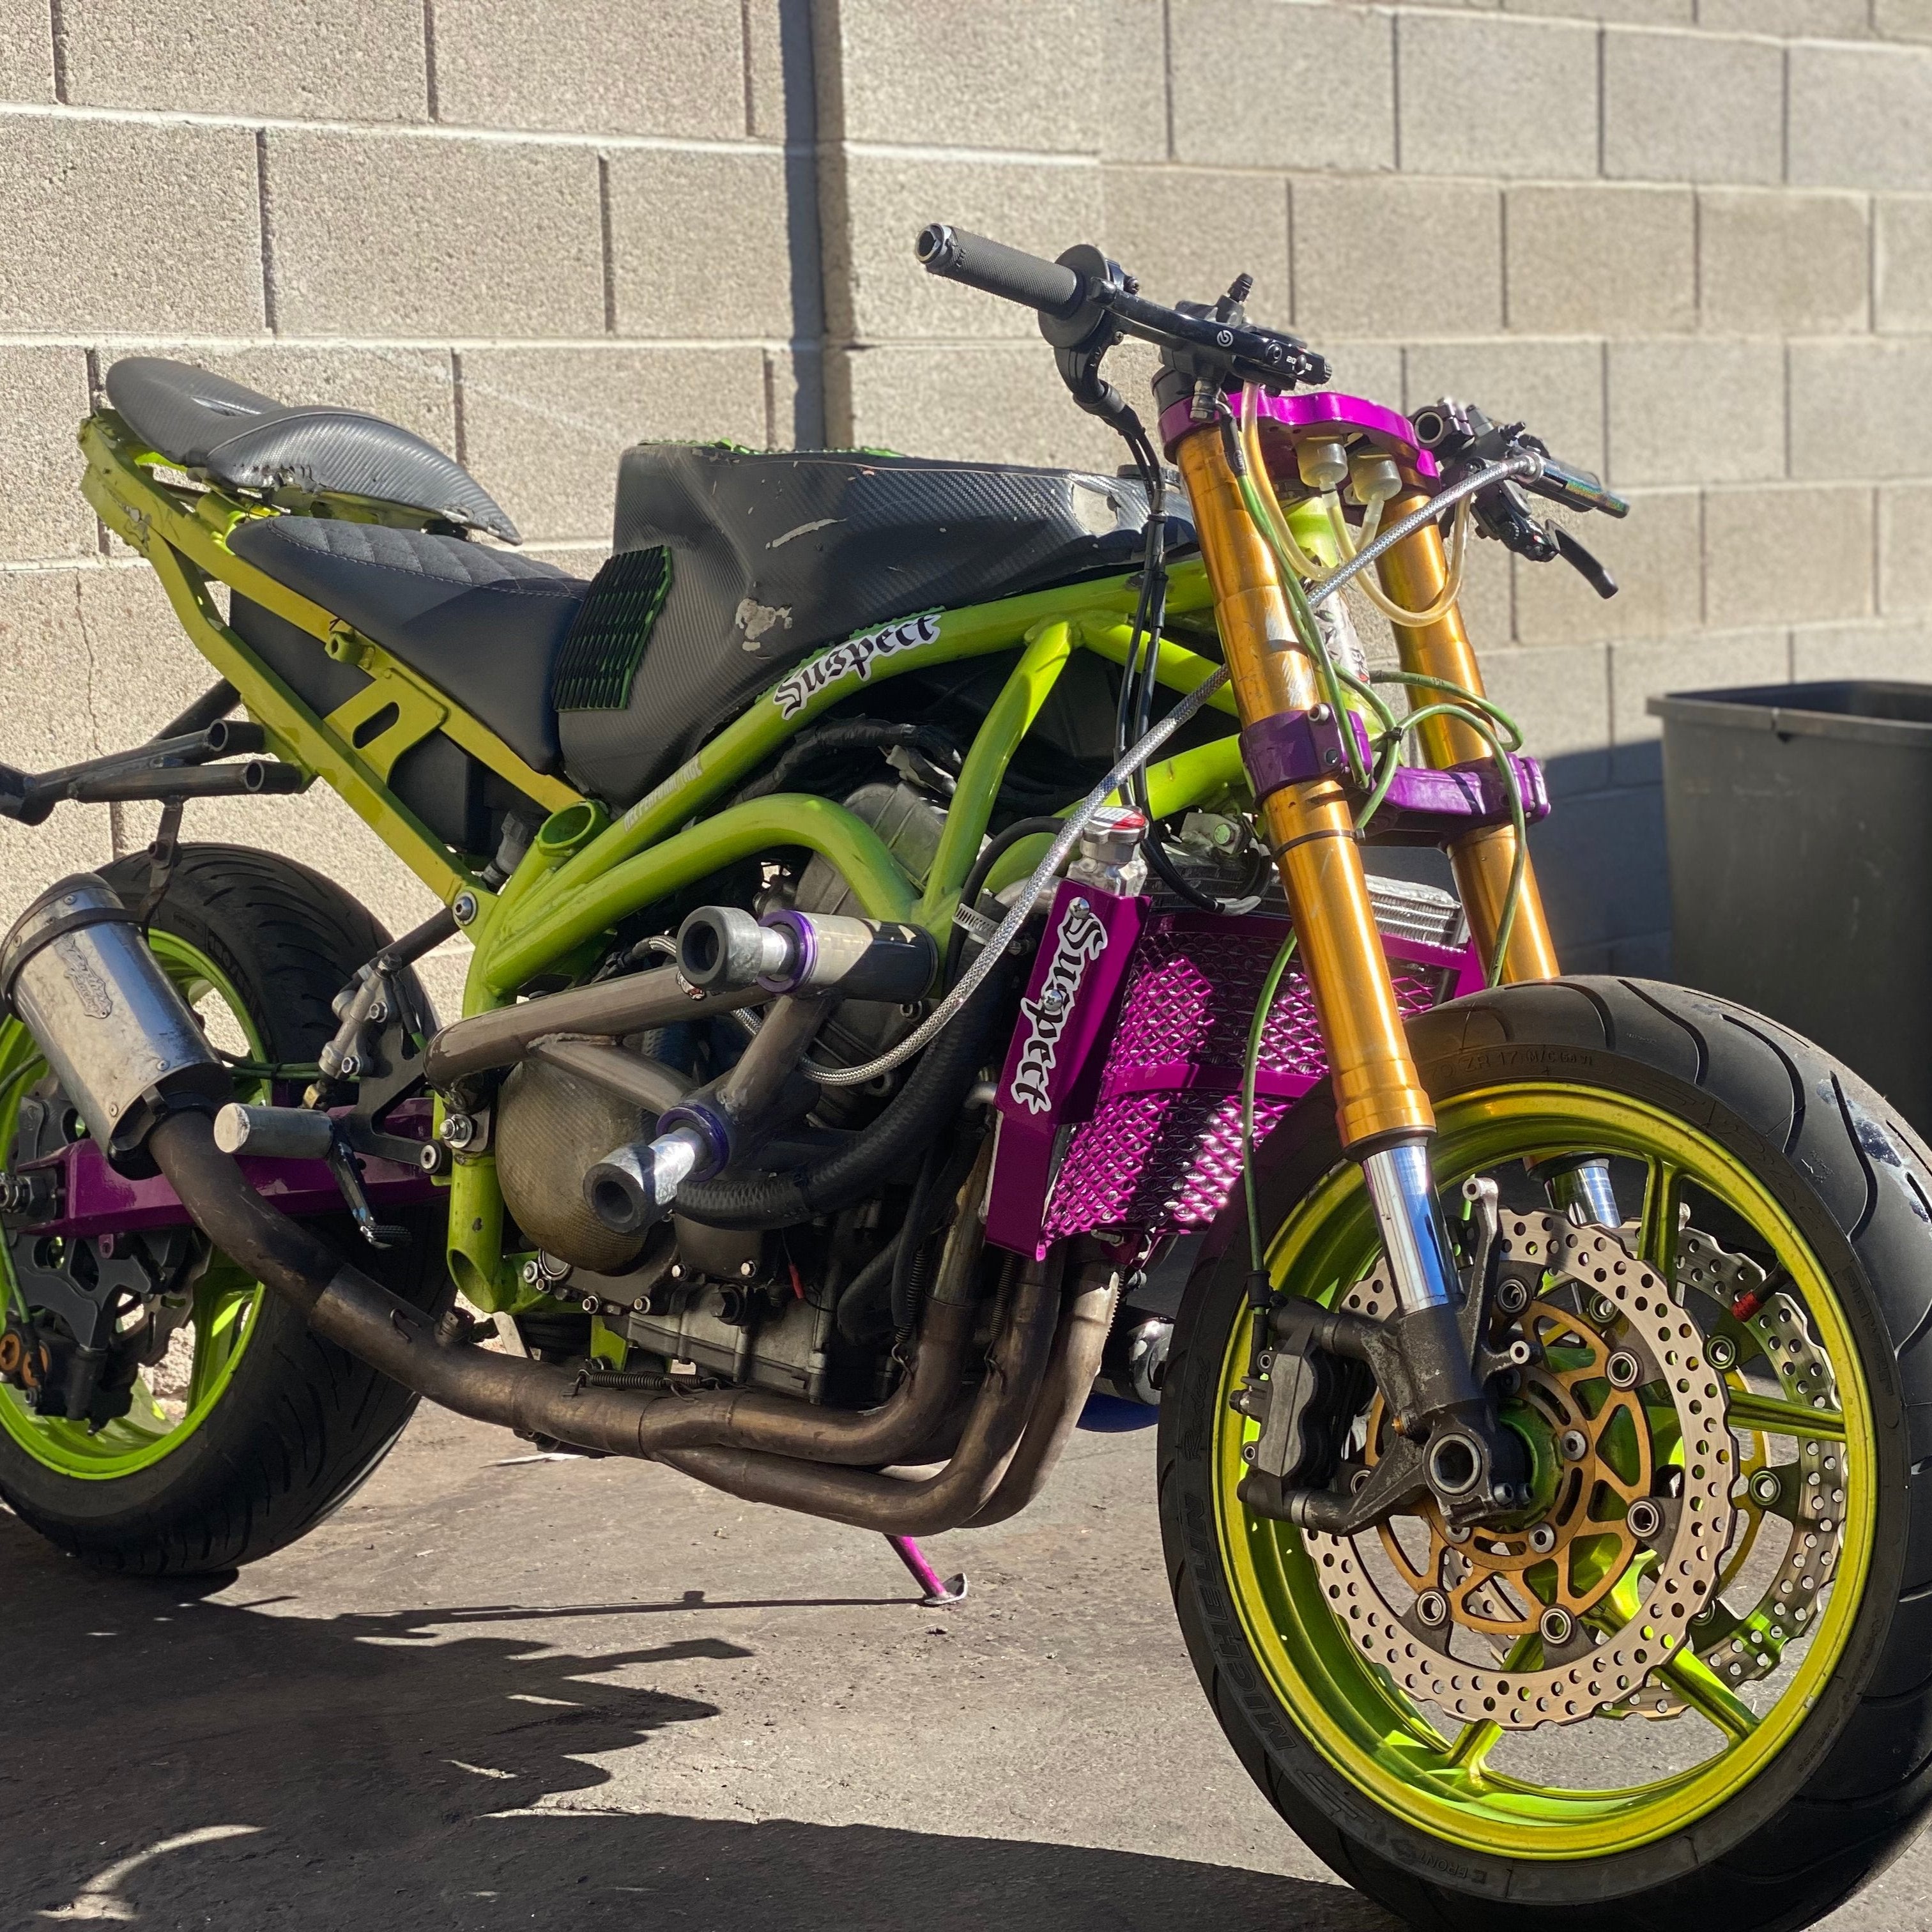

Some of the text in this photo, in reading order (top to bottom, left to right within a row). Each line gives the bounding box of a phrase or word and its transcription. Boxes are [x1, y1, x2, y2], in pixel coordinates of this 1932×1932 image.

[774, 615, 937, 718] Suspect
[1183, 1492, 1296, 1750] MICHELIN
[1419, 1851, 1468, 1878] FRONT
